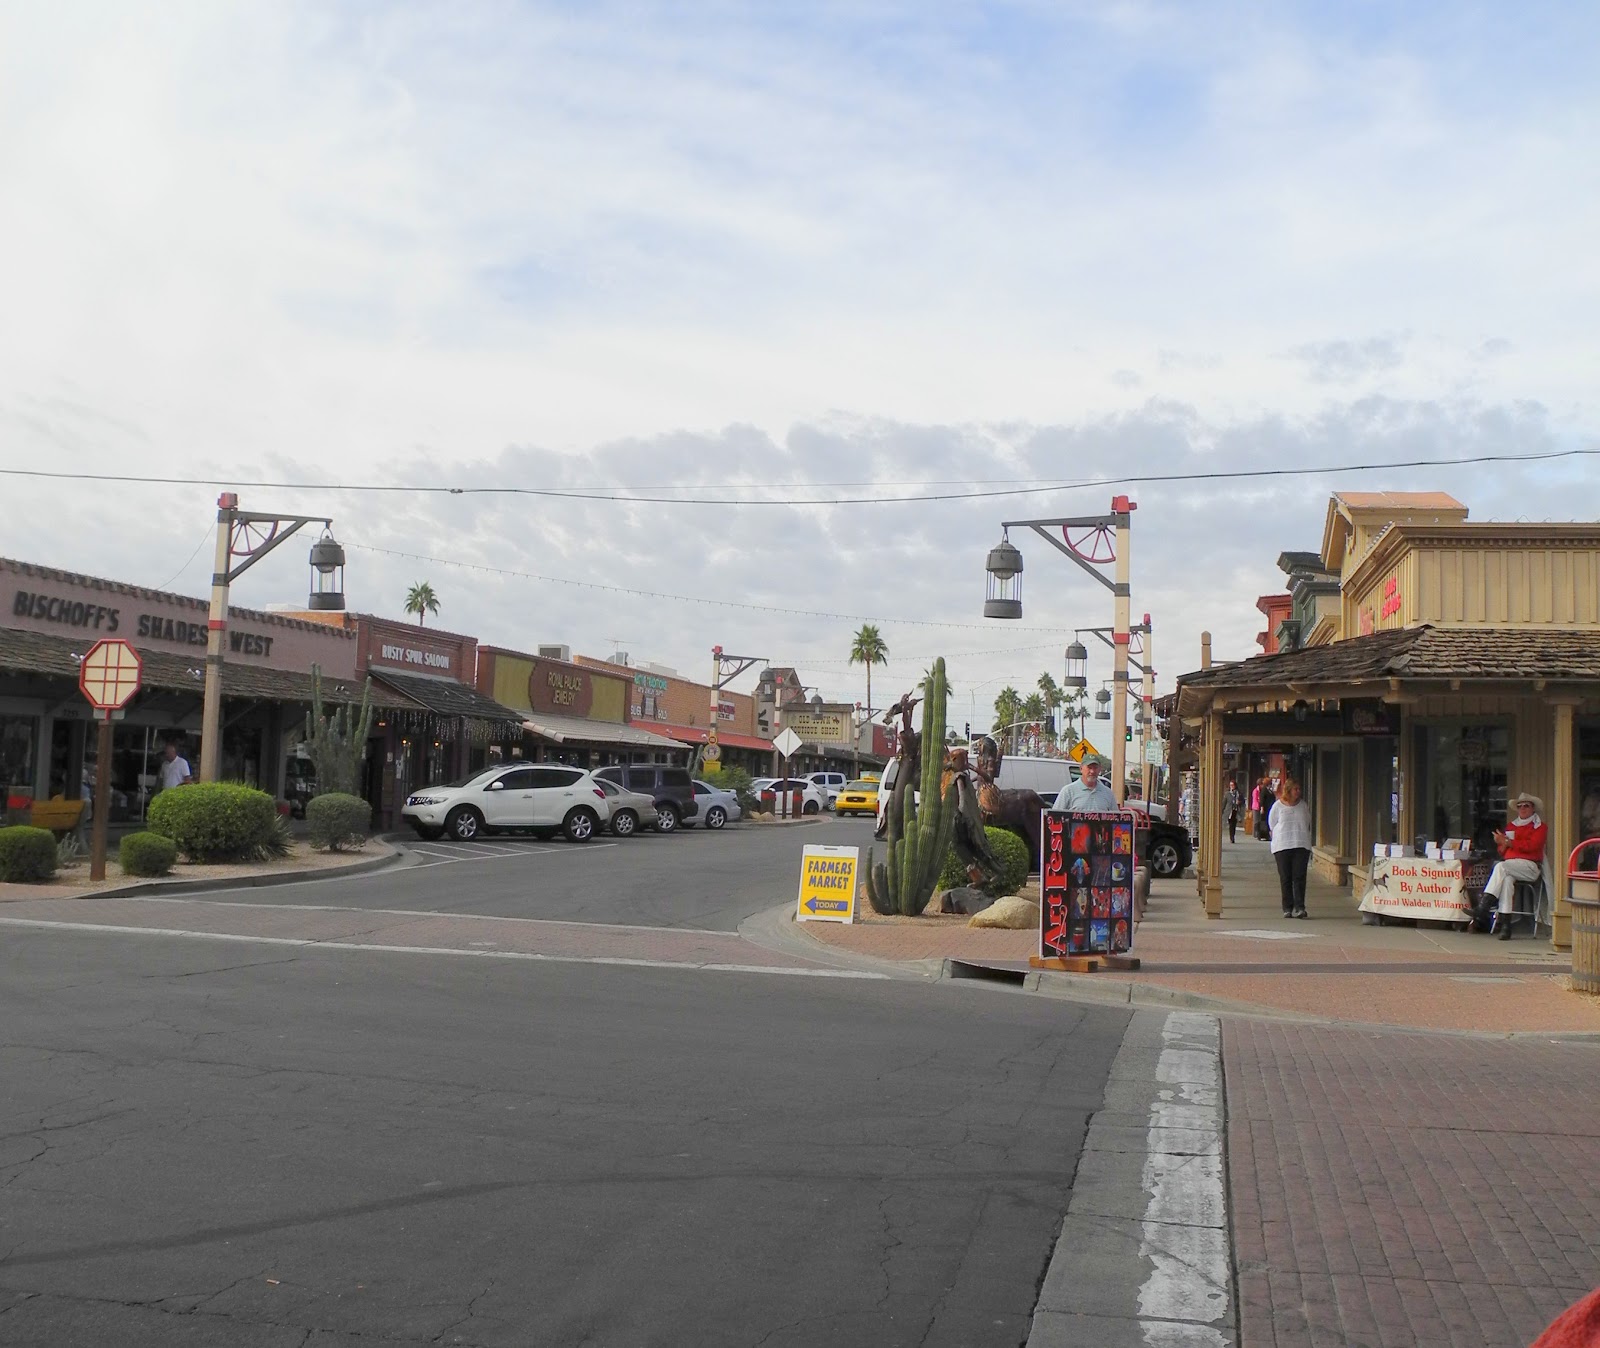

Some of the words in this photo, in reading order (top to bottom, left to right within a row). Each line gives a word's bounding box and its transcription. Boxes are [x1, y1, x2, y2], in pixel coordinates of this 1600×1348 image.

[13, 591, 120, 632] BISCHOFF'S
[137, 614, 208, 646] SHADES
[229, 631, 274, 656] WEST
[382, 644, 404, 661] RUSTY
[405, 649, 423, 665] SPUR
[424, 652, 449, 669] SALOON
[548, 672, 563, 688] ROYAL
[564, 675, 582, 691] PALACE
[553, 690, 575, 705] JEWELRY
[799, 715, 810, 724] OLD
[821, 727, 839, 735] SHOPS
[808, 860, 853, 875] FARMERS
[1392, 865, 1418, 877] Book
[1421, 867, 1461, 881] Signing
[808, 875, 849, 890] MARKET
[1400, 881, 1413, 895] By
[1416, 882, 1452, 894] Author
[815, 901, 840, 909] TODAY
[1373, 896, 1399, 906] Ermal
[1401, 898, 1432, 908] Walden
